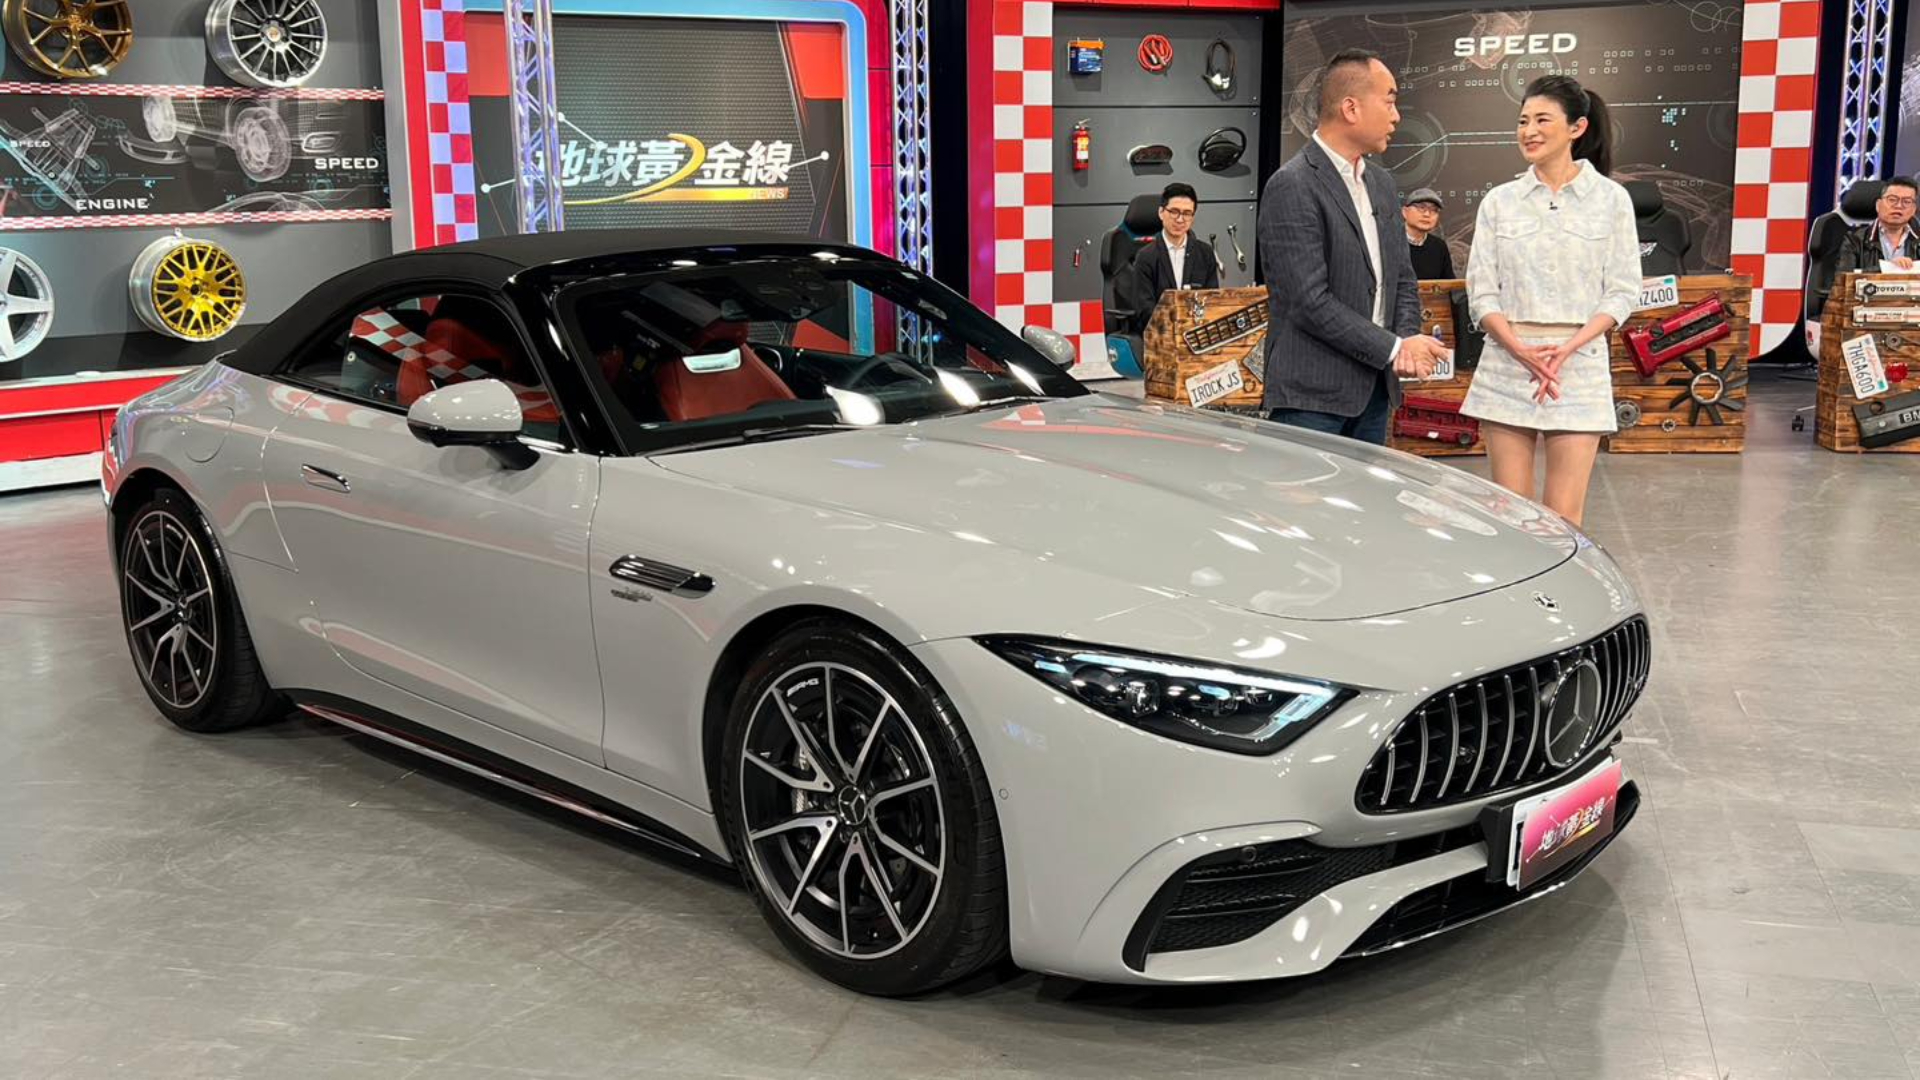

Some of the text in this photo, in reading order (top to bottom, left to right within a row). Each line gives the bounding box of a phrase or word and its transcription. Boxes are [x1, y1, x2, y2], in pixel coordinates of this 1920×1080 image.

[1453, 32, 1578, 58] SPEED
[9, 139, 51, 149] SPEED
[314, 157, 379, 170] SPEED
[76, 197, 149, 211] ENGINE
[1638, 286, 1674, 307] Z400
[1191, 377, 1225, 403] IROCK
[1226, 371, 1240, 388] JS
